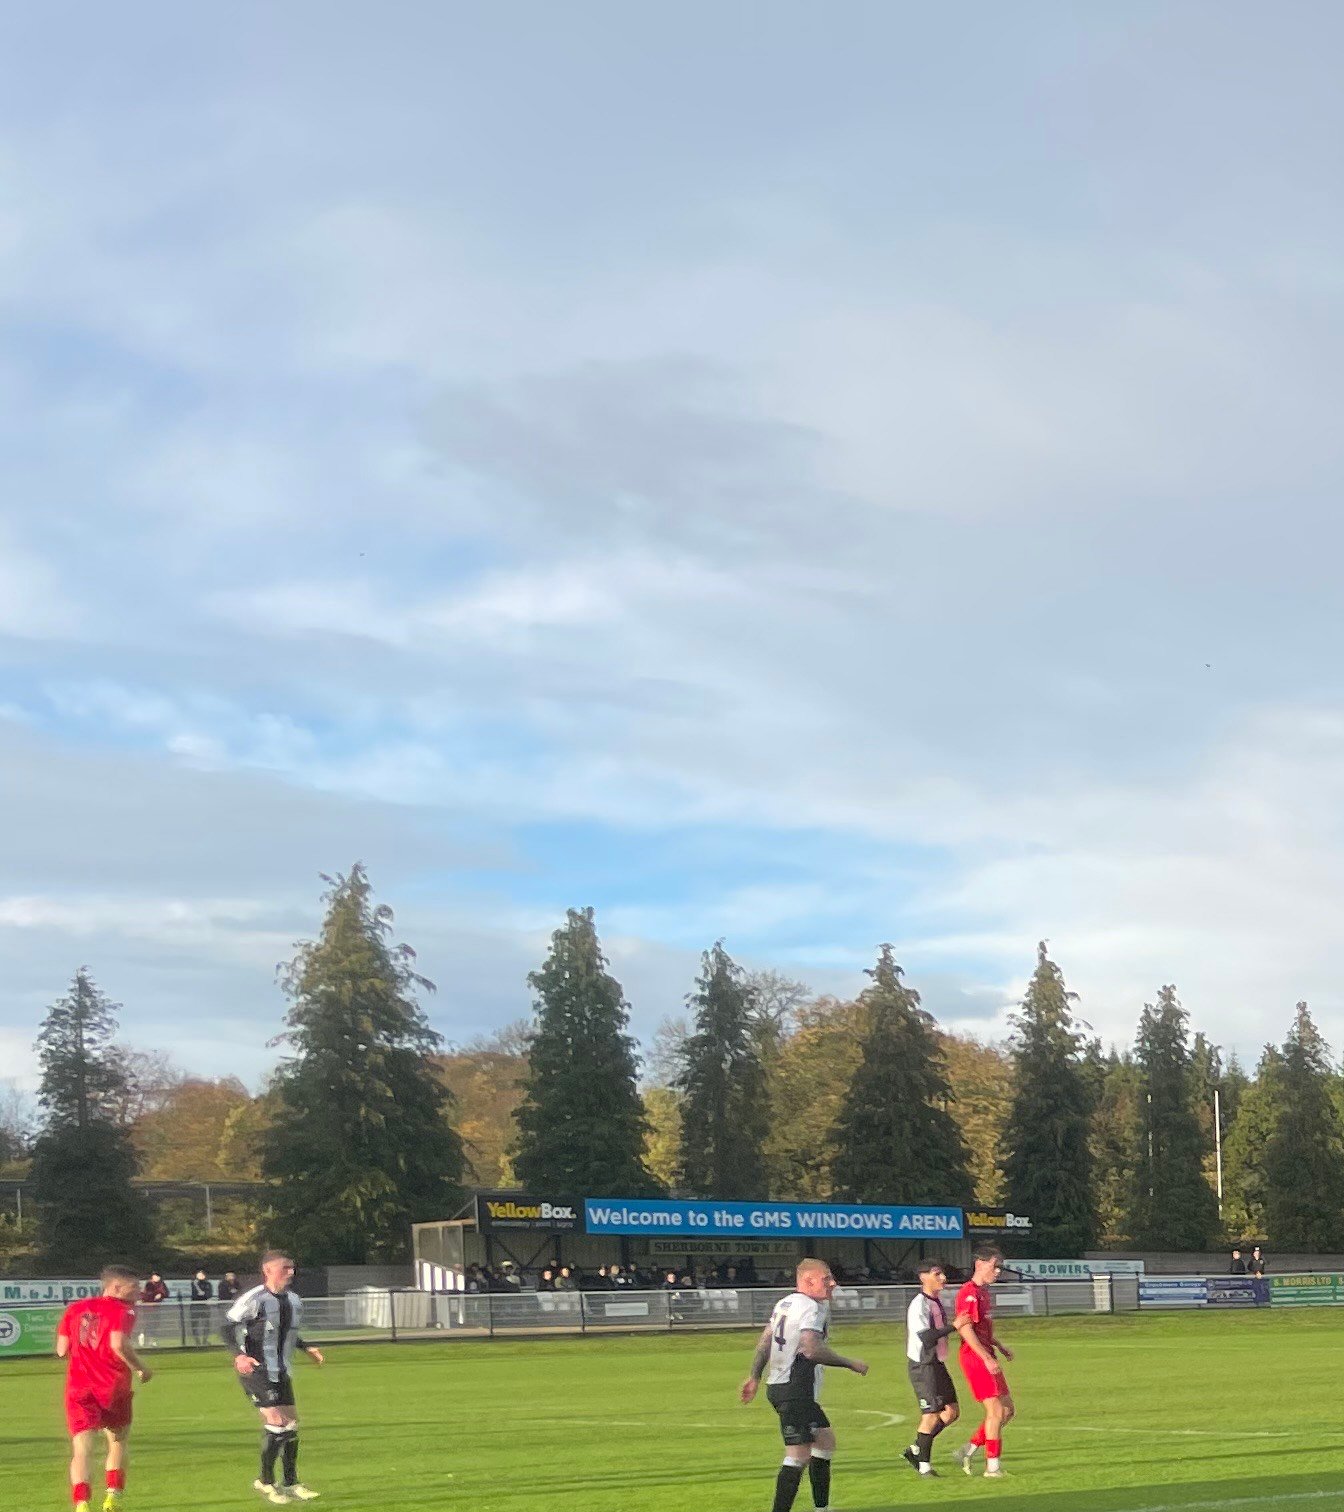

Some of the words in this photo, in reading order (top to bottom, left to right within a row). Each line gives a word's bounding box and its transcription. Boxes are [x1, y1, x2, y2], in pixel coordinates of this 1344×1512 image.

[588, 1207, 682, 1226] Welcome
[688, 1210, 708, 1227] to
[714, 1210, 744, 1228] the
[750, 1211, 792, 1229] GMS
[797, 1212, 893, 1230] WINDOWS
[899, 1214, 961, 1232] ARENA
